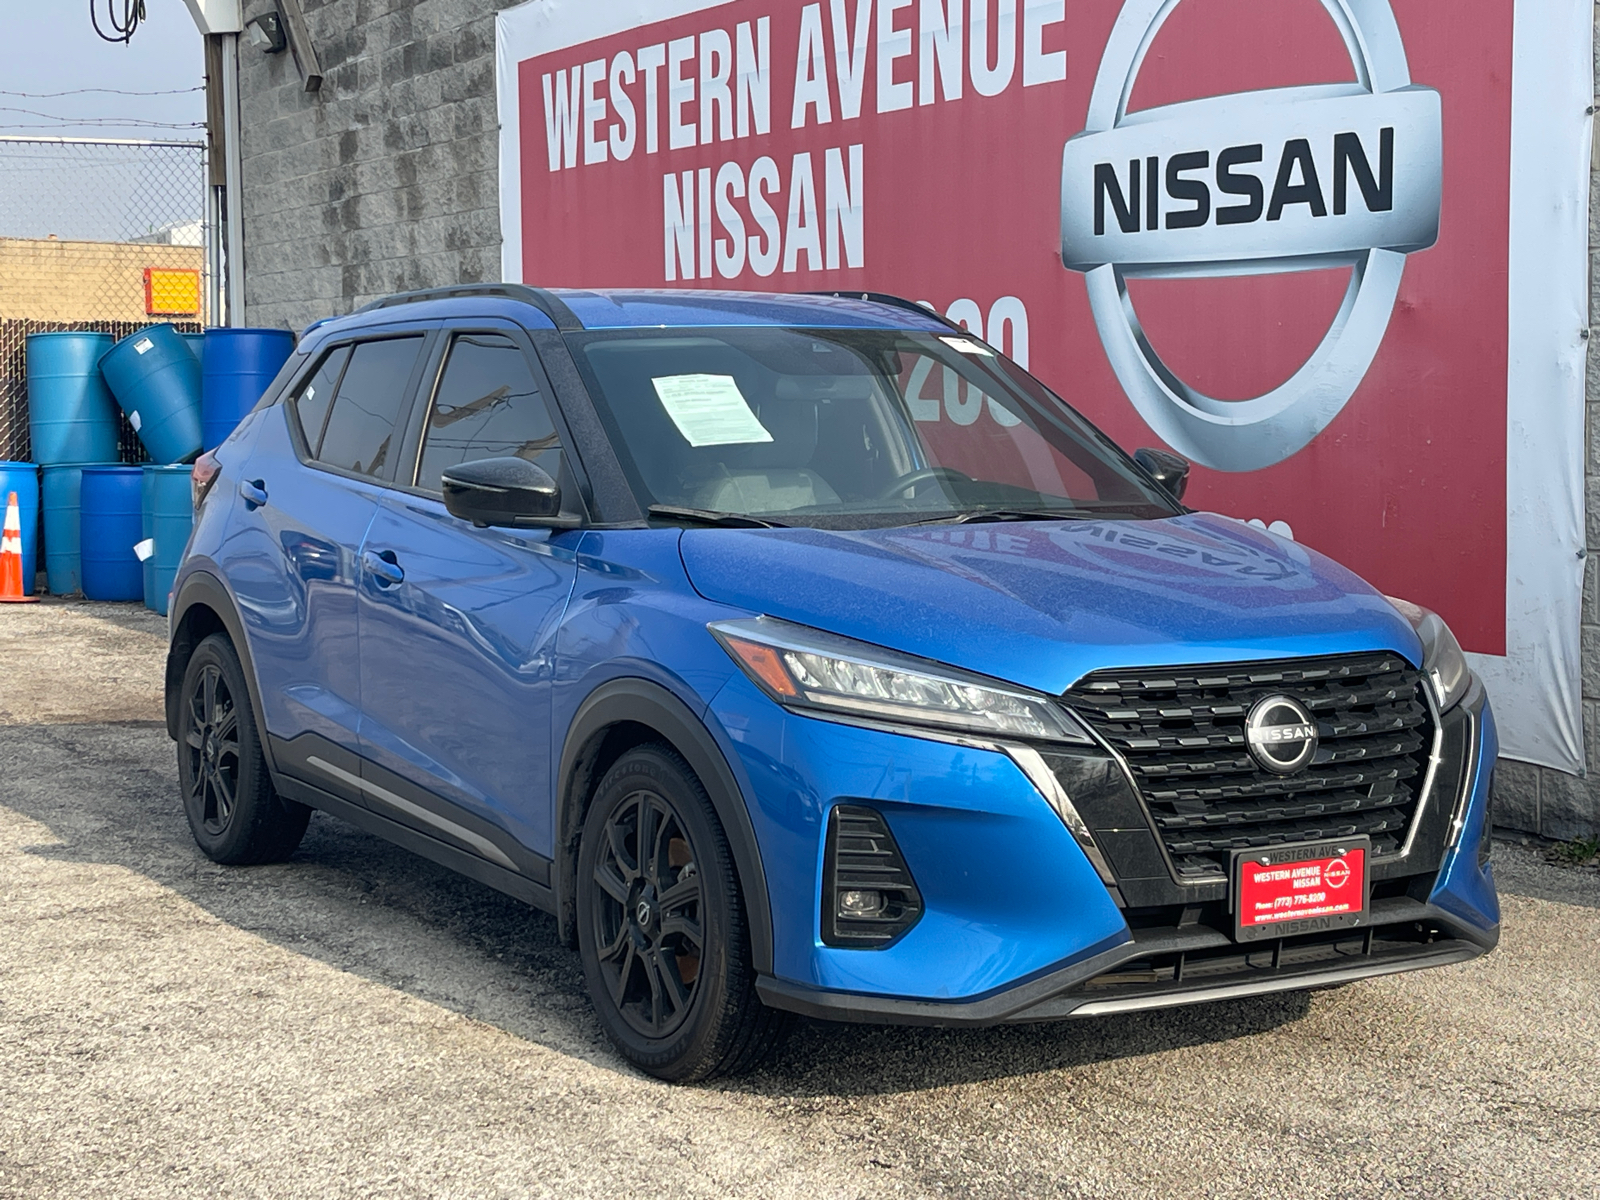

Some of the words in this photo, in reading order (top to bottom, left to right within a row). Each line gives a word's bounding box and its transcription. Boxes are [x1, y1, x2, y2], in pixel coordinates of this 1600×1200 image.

[542, 16, 770, 172] WESTERN
[791, 0, 1066, 129] AVENUE
[1094, 127, 1394, 235] NISSAN
[663, 144, 864, 282] NISSAN
[1252, 726, 1314, 741] NISSAN
[1269, 849, 1315, 863] WESTERN
[1254, 869, 1290, 883] WESTERN
[1291, 866, 1320, 878] AVENUE
[1324, 870, 1350, 878] NISSAN
[1293, 877, 1320, 889] NISSAN
[1274, 896, 1292, 909] (773)
[1275, 918, 1331, 936] NISSAN
